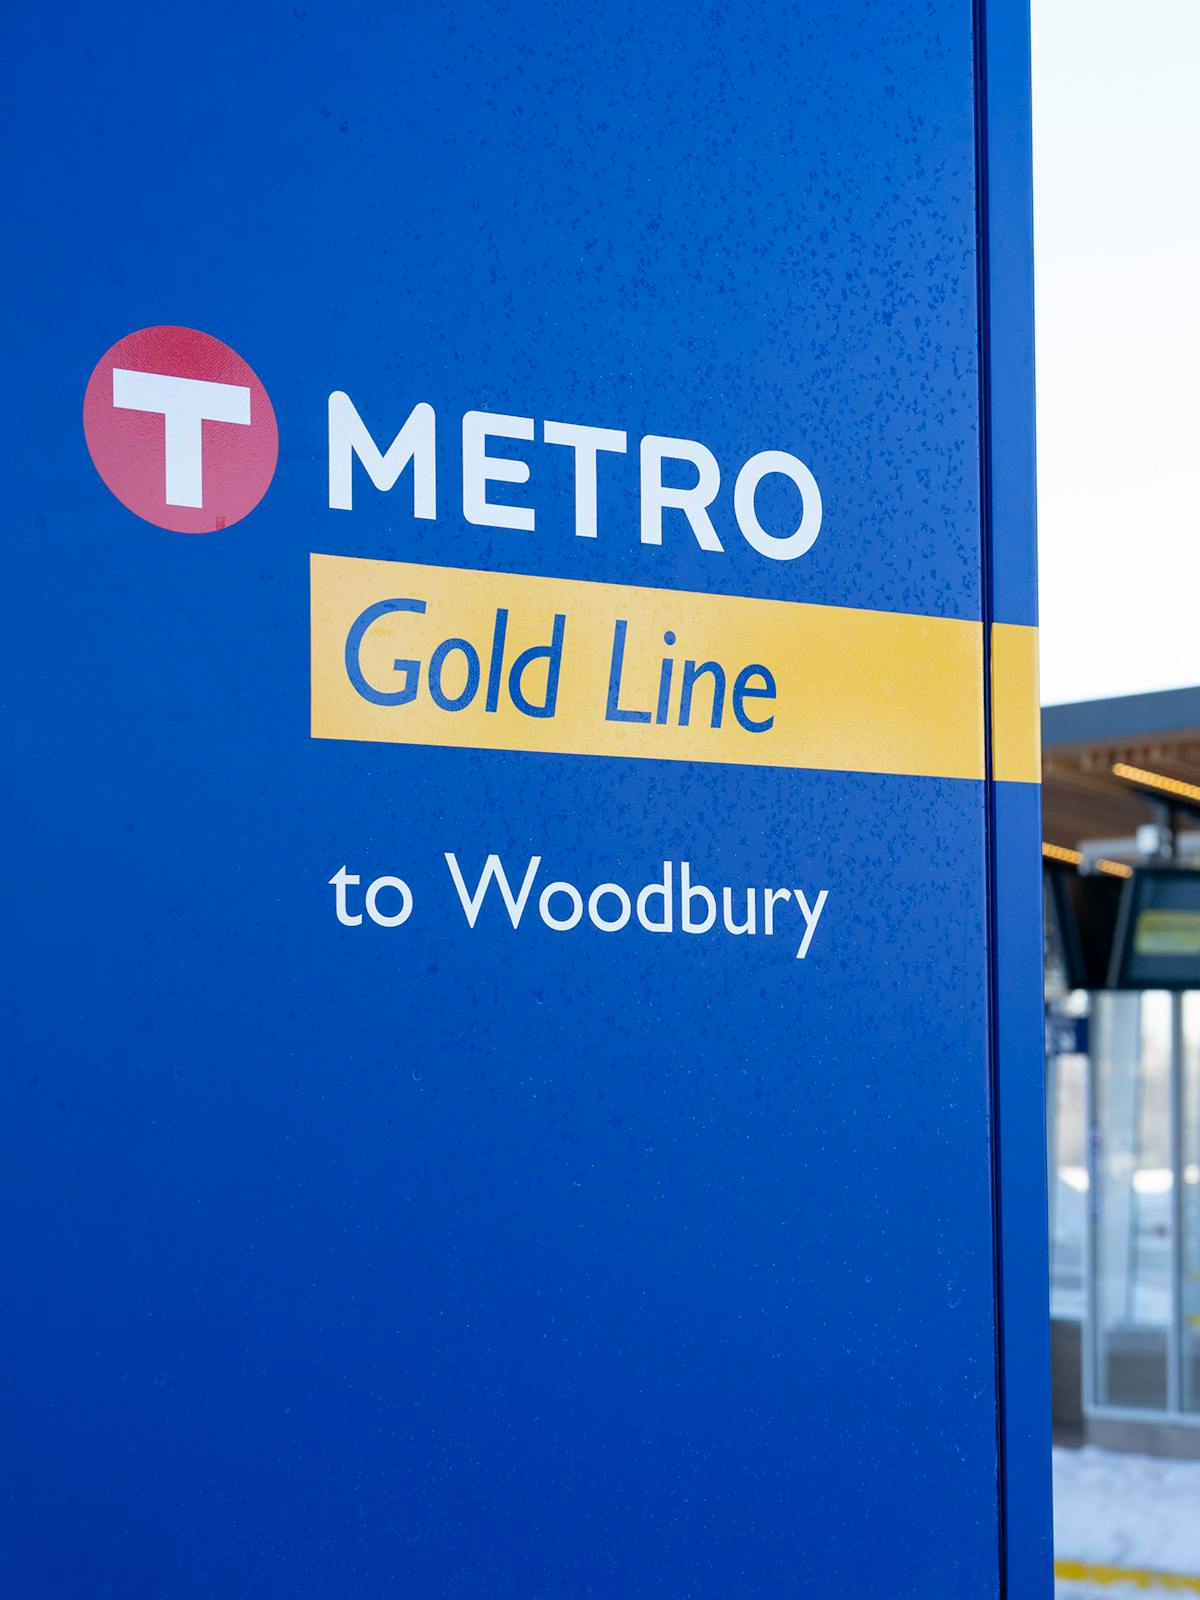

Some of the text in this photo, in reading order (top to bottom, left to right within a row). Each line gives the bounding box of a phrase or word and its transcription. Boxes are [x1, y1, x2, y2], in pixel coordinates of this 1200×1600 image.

[112, 367, 252, 509] T
[328, 390, 823, 561] METRO
[344, 597, 777, 734] Gold Line
[328, 852, 829, 959] to Woodbury
